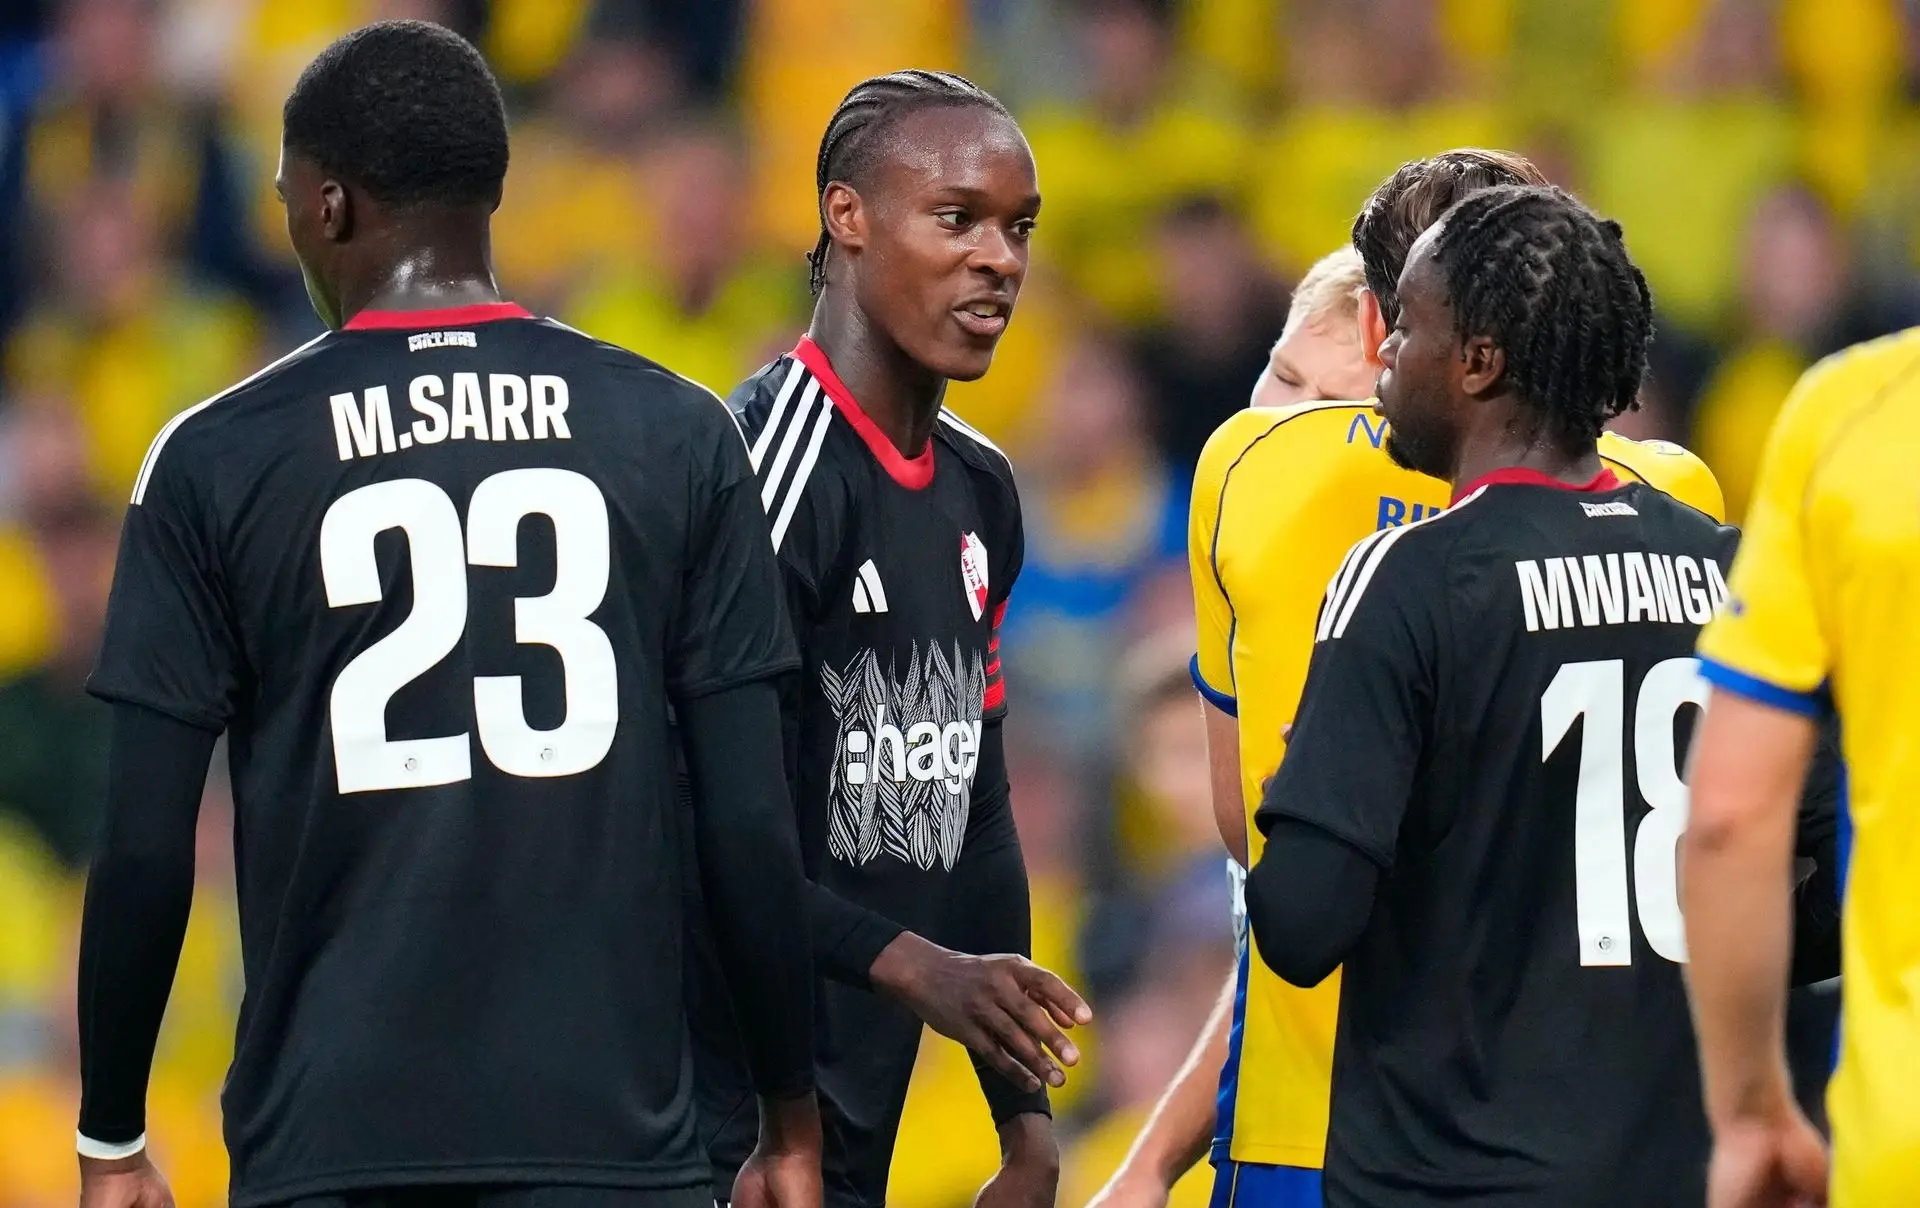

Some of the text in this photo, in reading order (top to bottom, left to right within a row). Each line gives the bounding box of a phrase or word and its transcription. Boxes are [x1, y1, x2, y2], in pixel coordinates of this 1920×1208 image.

[330, 373, 571, 460] M.SARR
[320, 468, 618, 794] 23
[1541, 657, 1712, 966] 18
